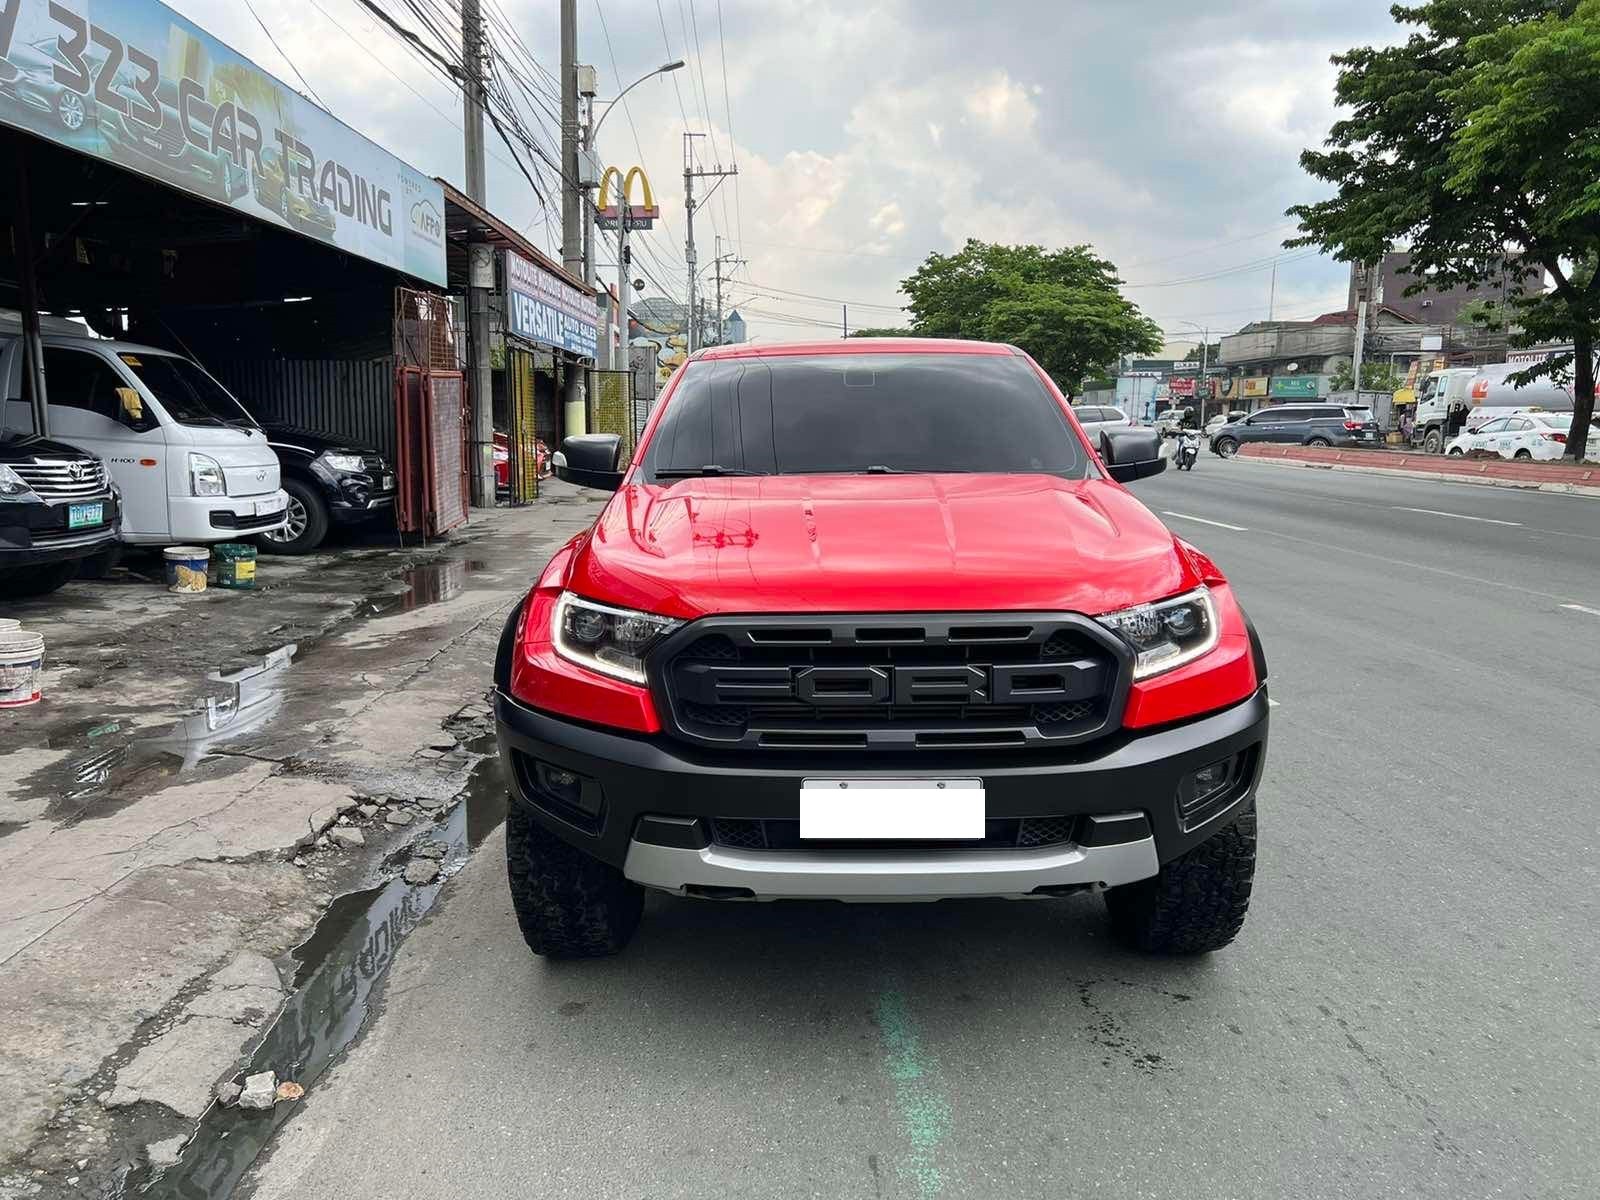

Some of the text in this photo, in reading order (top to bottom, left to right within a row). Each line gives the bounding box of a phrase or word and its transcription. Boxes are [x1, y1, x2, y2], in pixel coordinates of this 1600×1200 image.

[48, 0, 163, 129] 323
[179, 77, 266, 179] CAR
[273, 127, 393, 237] TRADING
[513, 291, 565, 345] VERSATILE
[564, 315, 597, 341] AUTO SALES
[690, 664, 1100, 705] FORD
